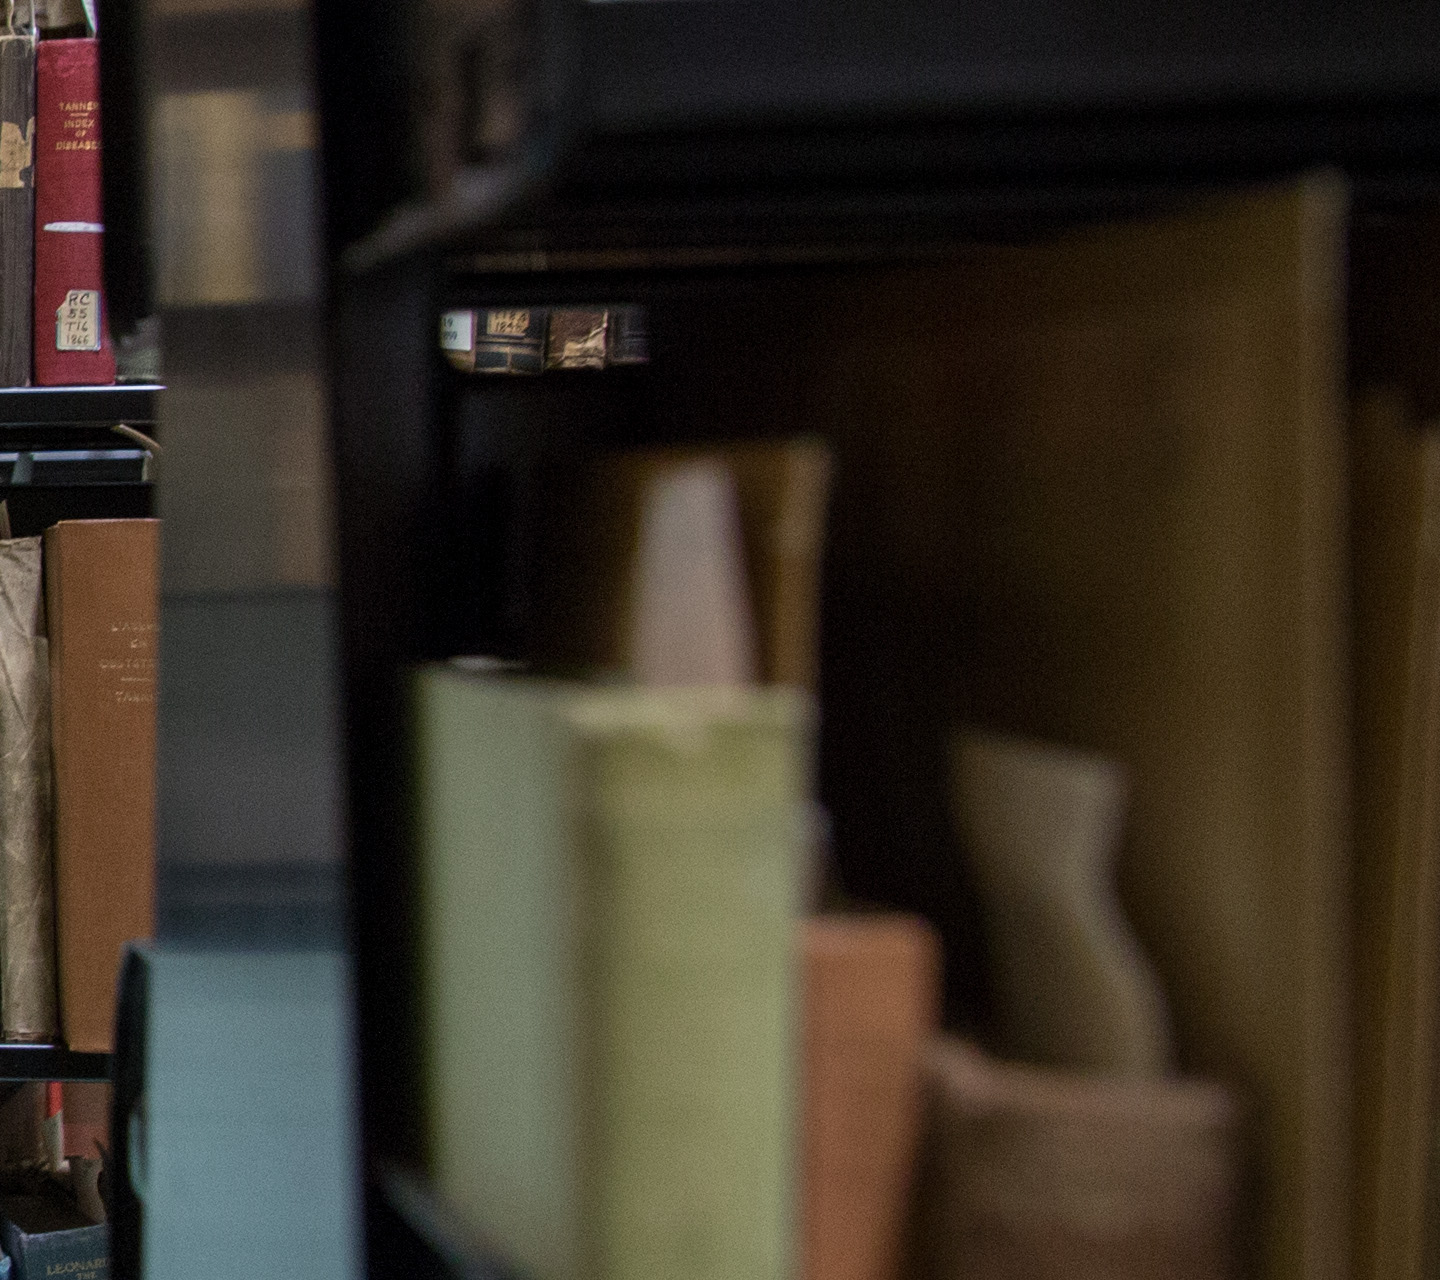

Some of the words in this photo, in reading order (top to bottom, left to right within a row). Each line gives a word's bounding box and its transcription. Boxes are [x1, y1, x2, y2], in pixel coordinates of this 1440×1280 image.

[63, 118, 95, 129] INDEX
[55, 140, 100, 151] DISEASE
[67, 292, 91, 307] RC
[67, 308, 88, 320] 55
[45, 1257, 108, 1276] LEONAR
[76, 1271, 98, 1280] THE
